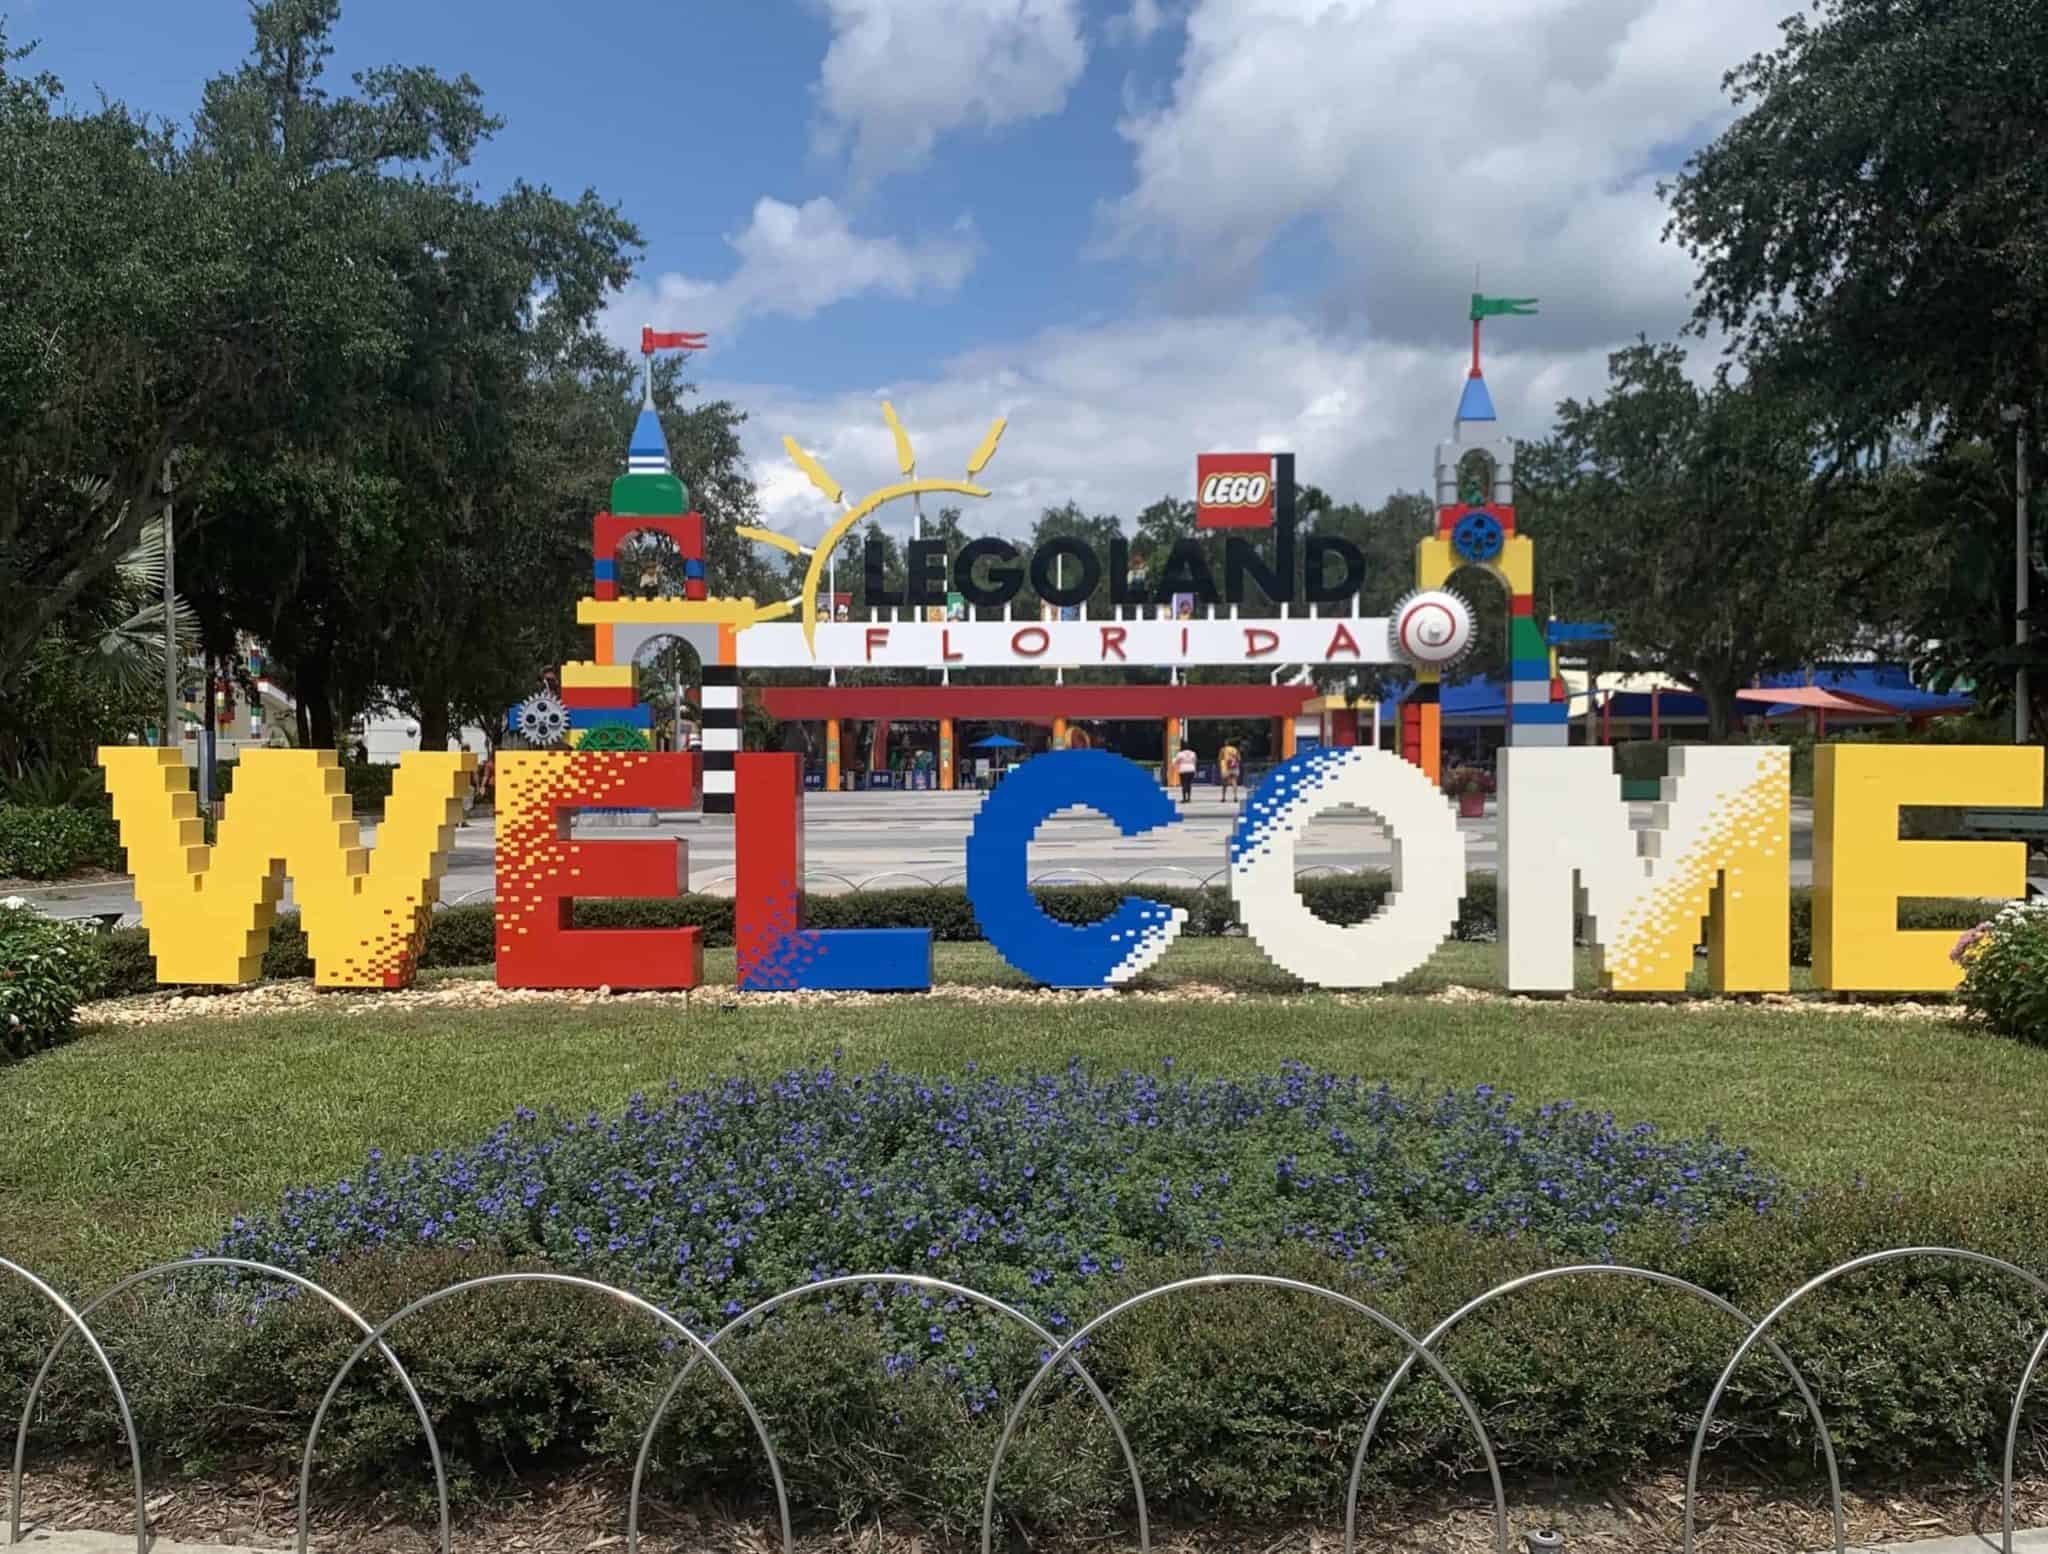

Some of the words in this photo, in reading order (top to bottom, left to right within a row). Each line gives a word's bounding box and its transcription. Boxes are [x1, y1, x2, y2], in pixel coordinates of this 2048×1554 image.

[863, 454, 1366, 606] LEGOLAND
[1203, 476, 1267, 504] LEGO
[866, 625, 1361, 661] FLORIDA
[97, 745, 2045, 992] WELCOME
